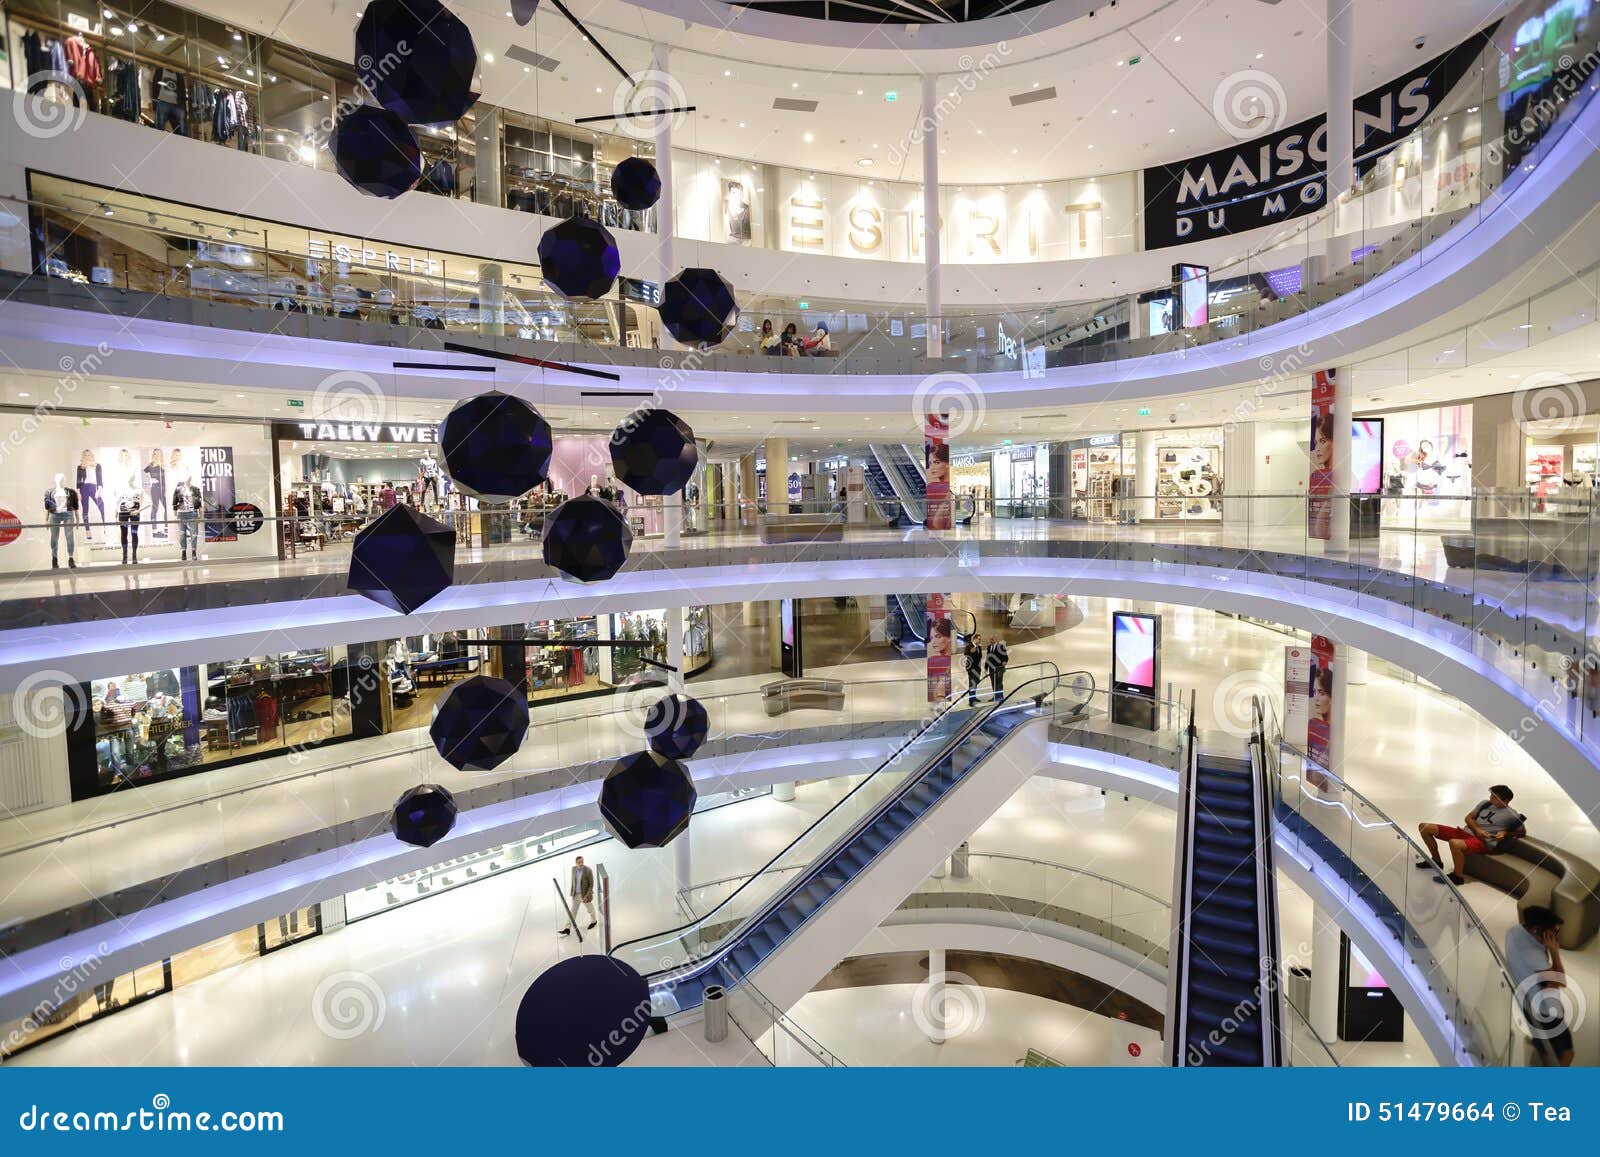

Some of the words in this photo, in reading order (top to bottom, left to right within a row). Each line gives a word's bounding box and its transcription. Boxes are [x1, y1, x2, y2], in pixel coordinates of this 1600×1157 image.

[1176, 208, 1226, 238] DU
[309, 240, 437, 275] ESPRIT
[997, 321, 1018, 360] fnac
[298, 424, 381, 441] TALLY
[200, 449, 226, 463] FIND
[200, 463, 233, 477] YOUR
[201, 478, 217, 492] FIT
